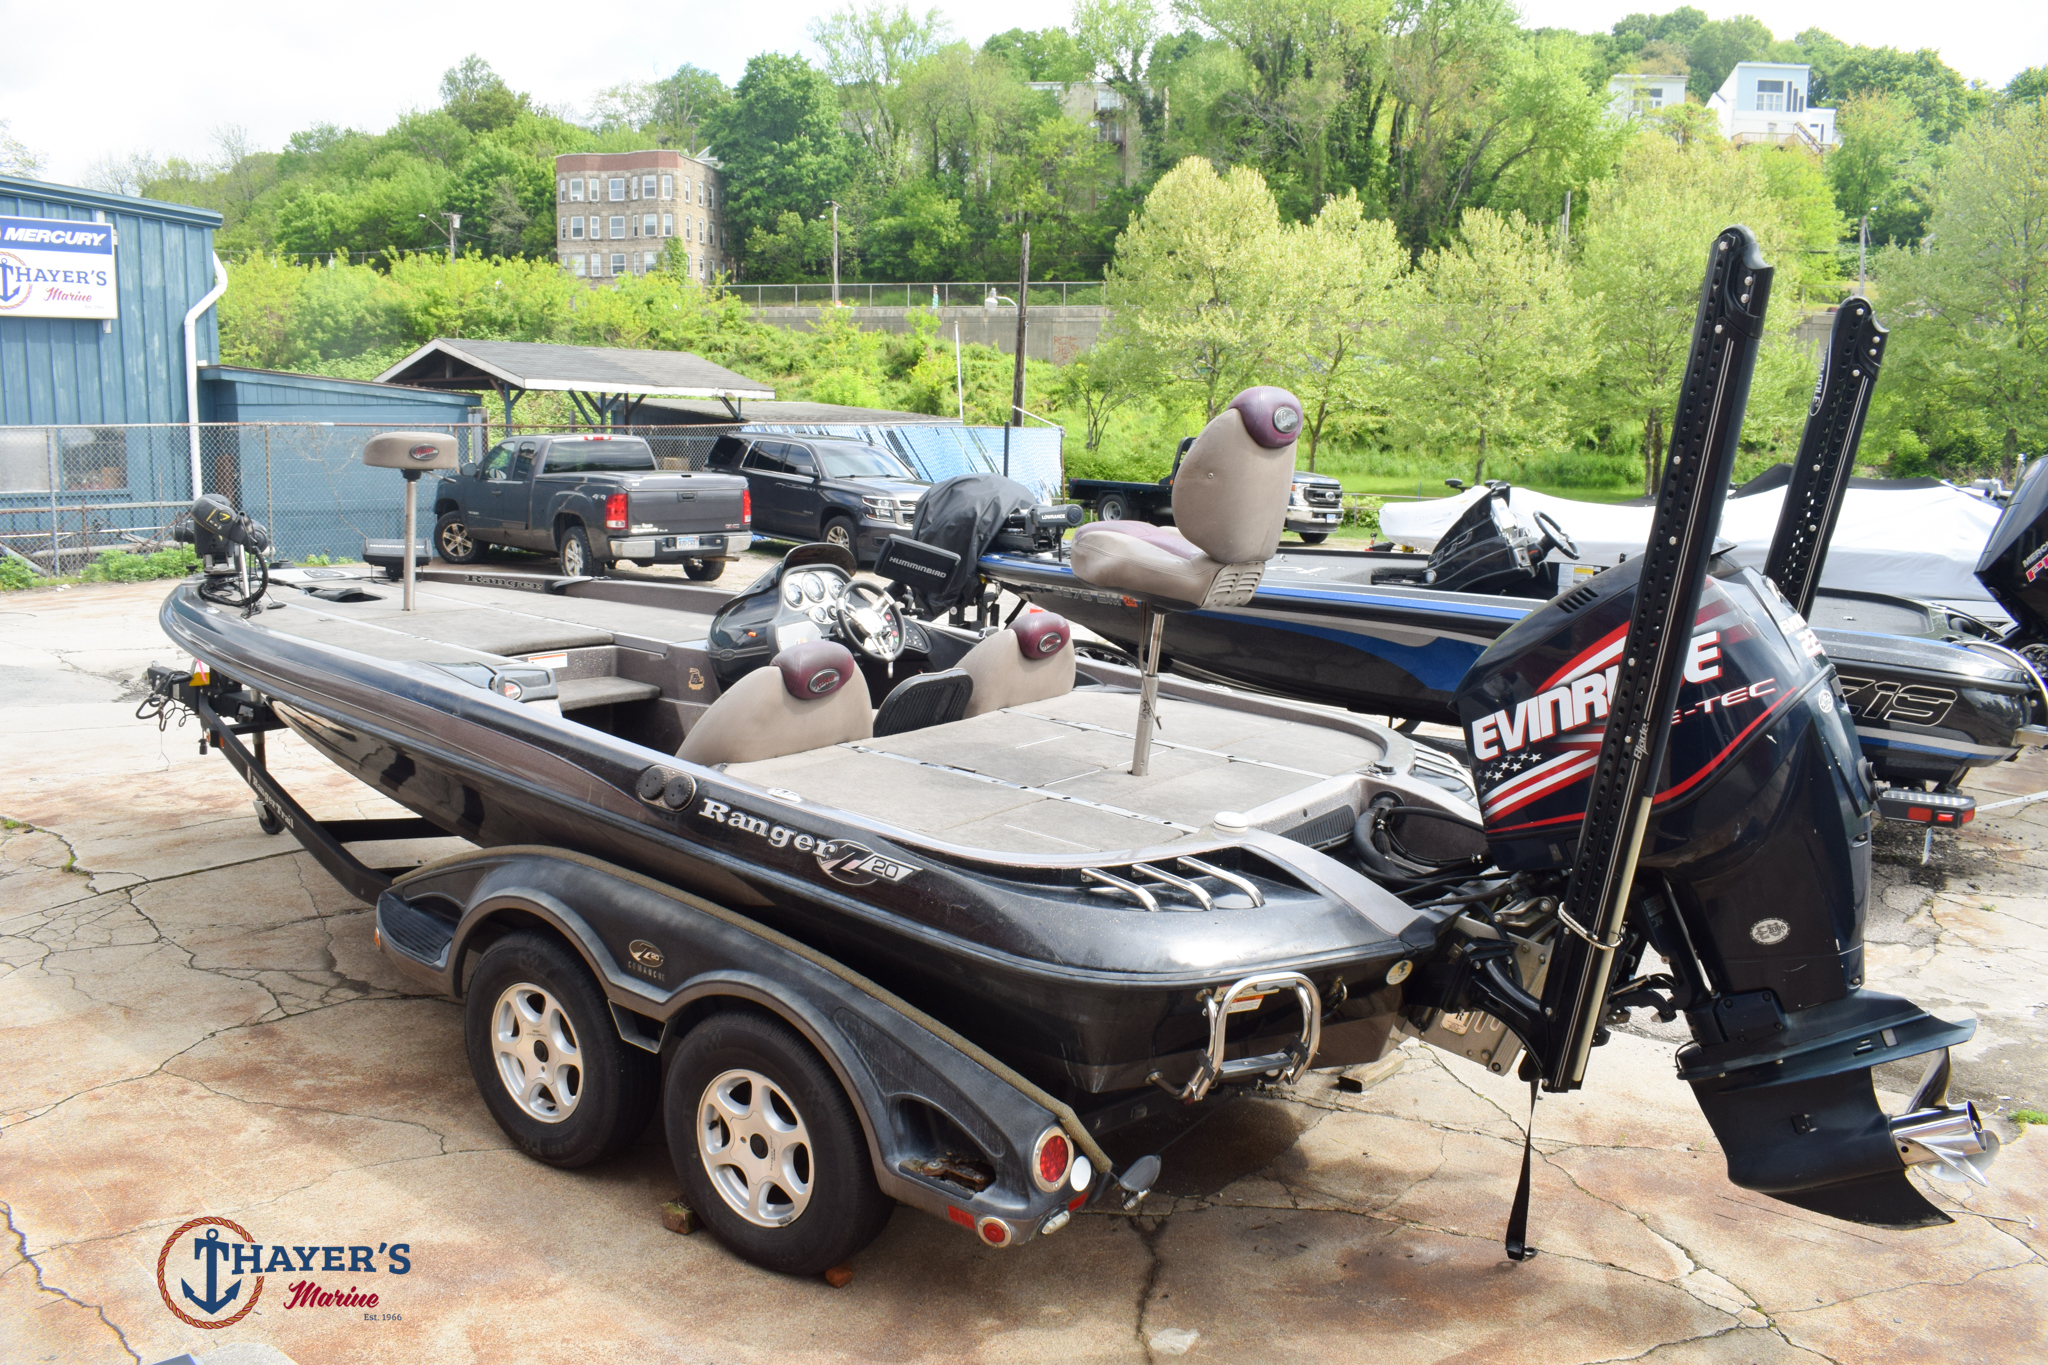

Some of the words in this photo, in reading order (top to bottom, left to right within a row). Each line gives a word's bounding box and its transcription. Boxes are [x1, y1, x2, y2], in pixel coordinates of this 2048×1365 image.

[4, 227, 107, 246] MERCURY
[43, 287, 92, 303] Marine
[1812, 375, 1824, 403] POLE
[889, 556, 948, 580] HUMMINBIRD
[2022, 541, 2048, 569] MERC
[465, 574, 544, 591] Ranger
[1472, 630, 1722, 762] EVINRE
[1633, 723, 1649, 761] Blade
[699, 797, 837, 860] Ranger
[628, 960, 666, 982] COMANCHE
